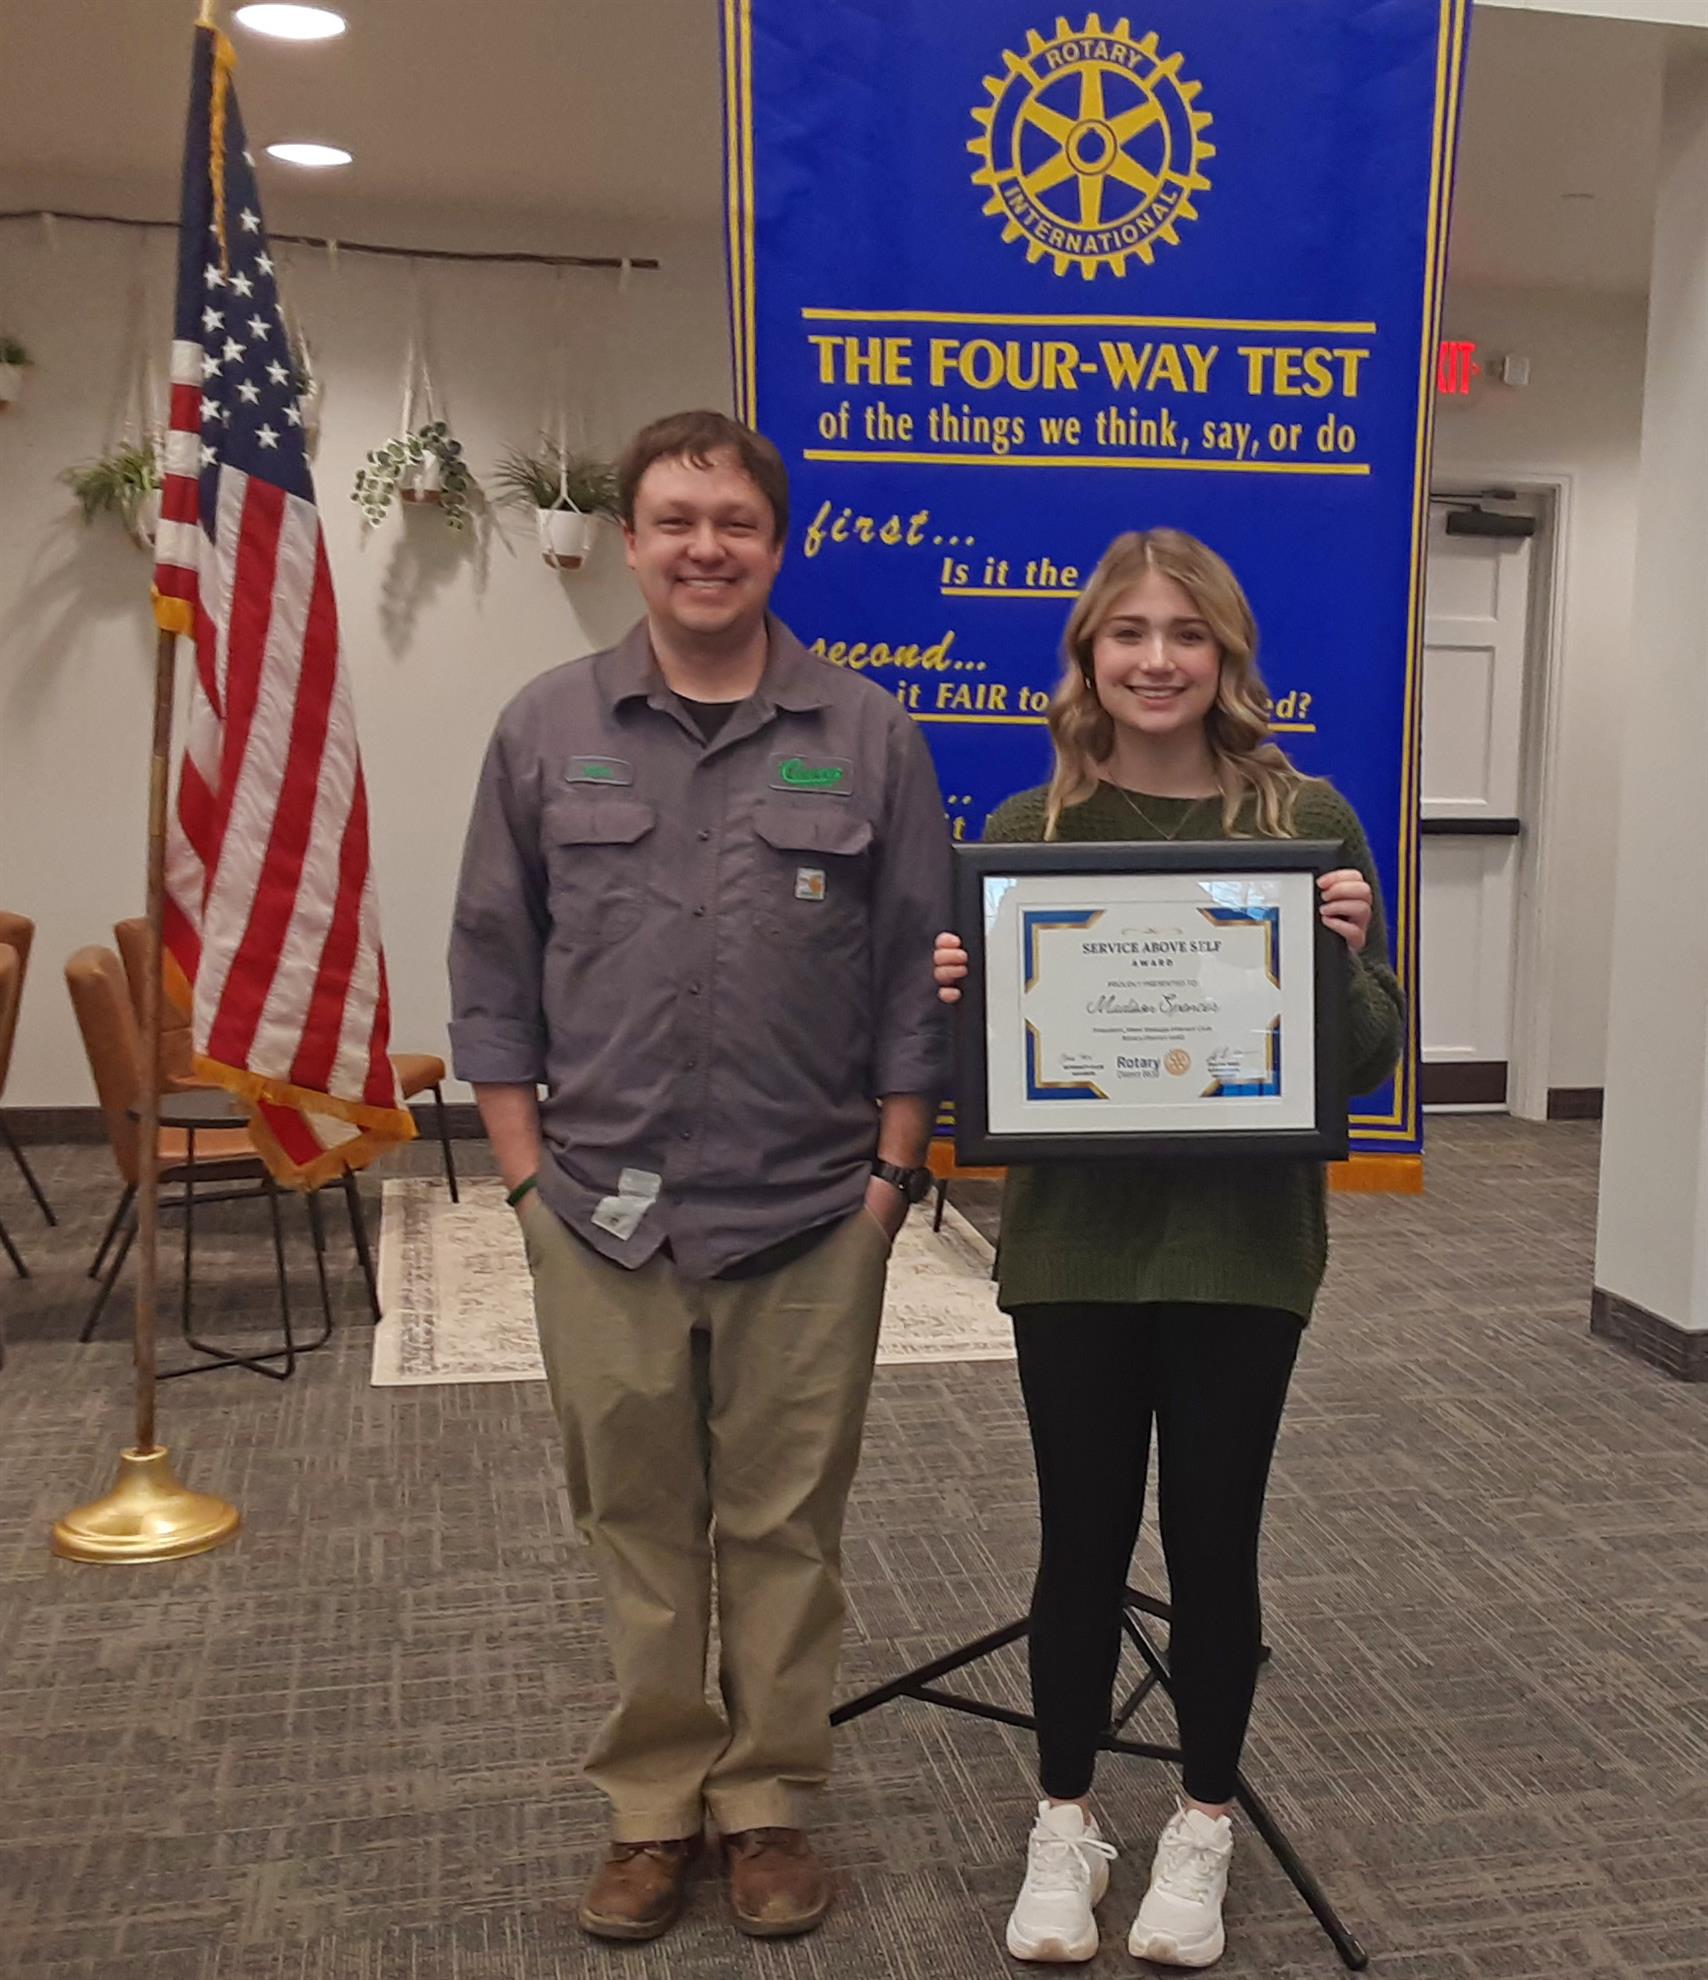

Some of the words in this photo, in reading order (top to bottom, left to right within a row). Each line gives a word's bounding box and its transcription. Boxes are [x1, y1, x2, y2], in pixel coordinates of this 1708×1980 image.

[1045, 39, 1143, 71] ROTARY
[1003, 185, 1178, 255] INTERNATIONAL
[809, 336, 912, 386] THE
[930, 339, 1219, 393] FOUR-WAY
[1238, 347, 1370, 398] TEST
[818, 401, 850, 440] of
[865, 401, 914, 441] the
[928, 402, 1026, 454] things
[1040, 418, 1081, 445] we
[1096, 406, 1190, 454] think,
[1202, 424, 1260, 461] say,
[1269, 425, 1302, 451] or
[1316, 413, 1357, 453] do
[804, 501, 975, 557] first...
[942, 559, 968, 585] Is
[985, 559, 1008, 586] it
[1026, 559, 1078, 588] the
[809, 629, 987, 672] second...
[897, 679, 922, 709] it
[936, 684, 1007, 710] FAIR
[1020, 688, 1052, 713] to
[1082, 942, 1140, 955] SERVICE
[1141, 940, 1186, 954] ABOVE
[1189, 940, 1223, 952] SELF
[1131, 957, 1175, 968] AWARD
[1116, 1055, 1160, 1071] Rotary
